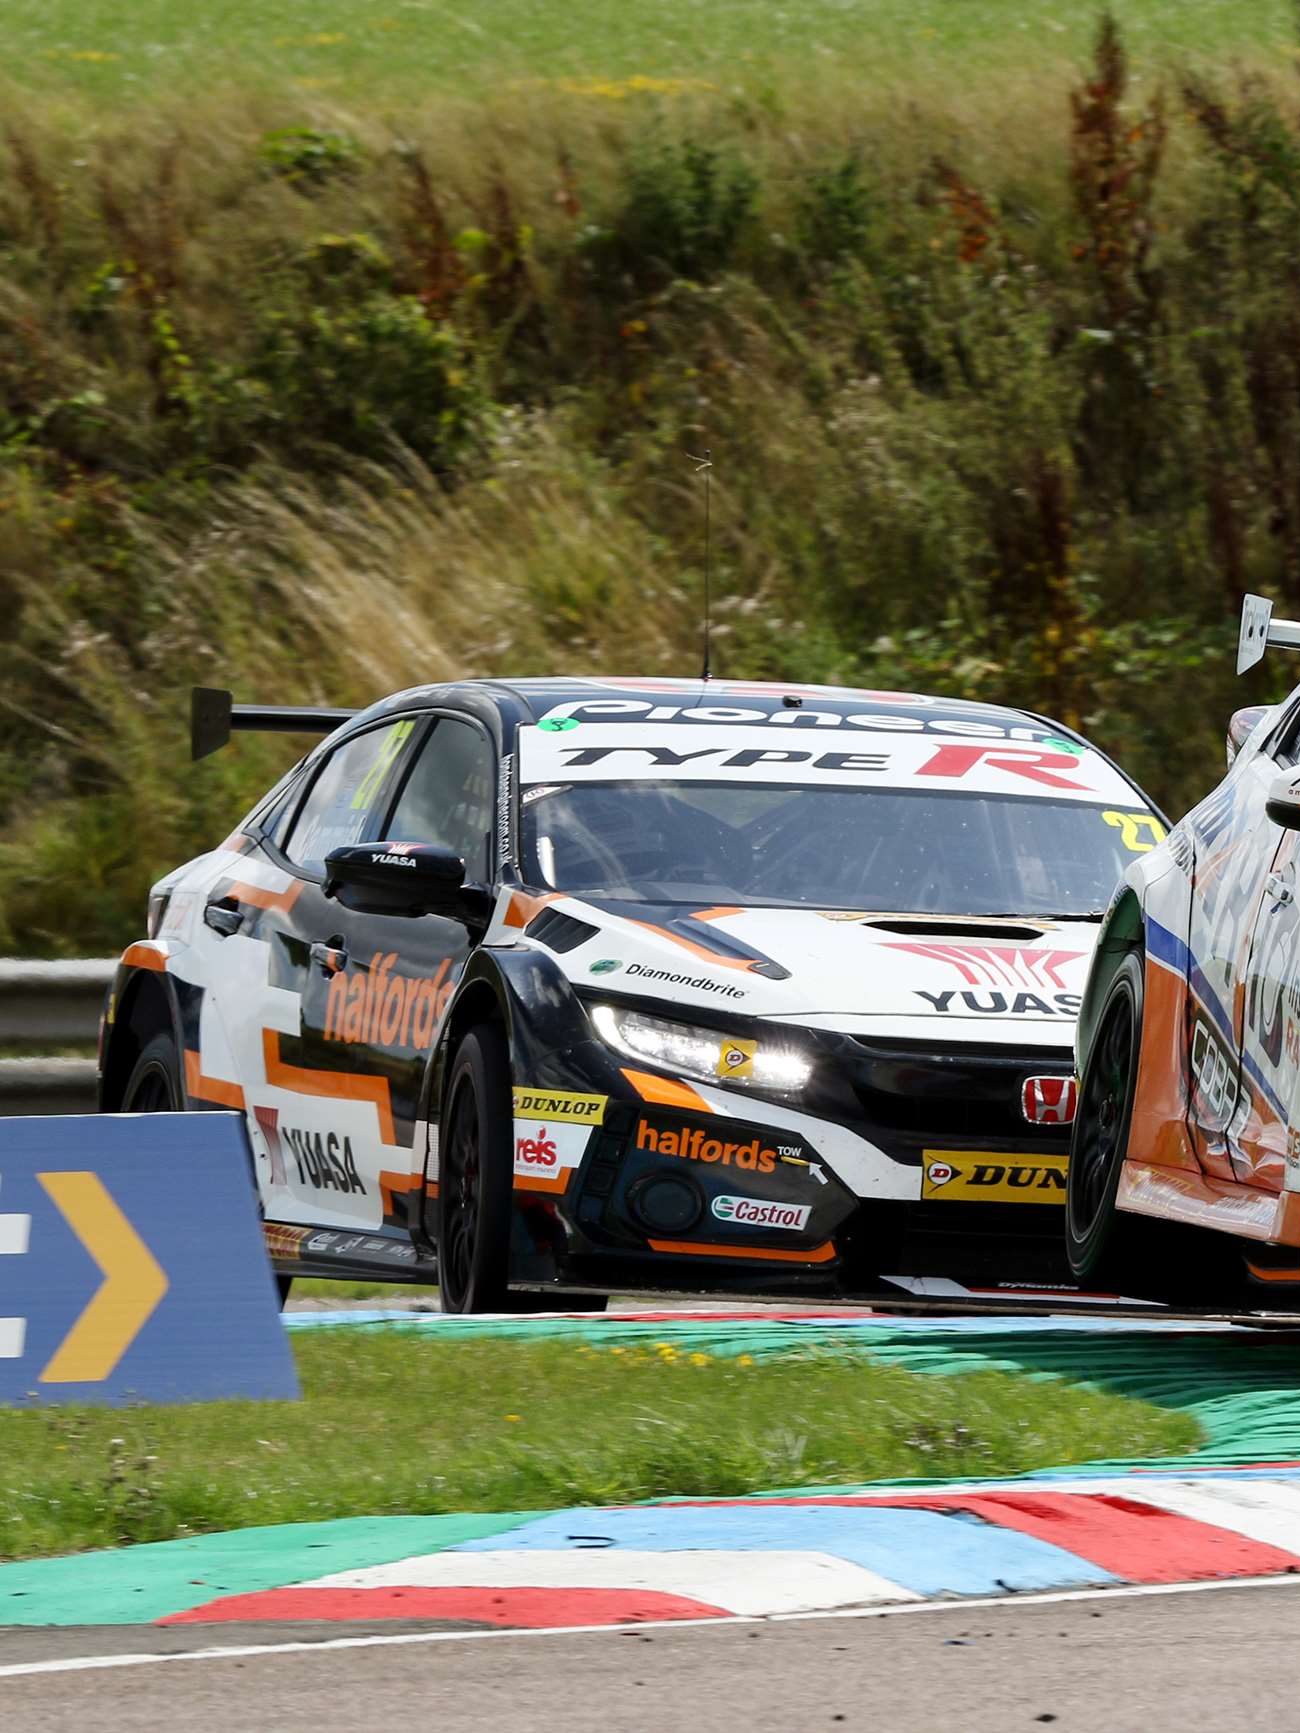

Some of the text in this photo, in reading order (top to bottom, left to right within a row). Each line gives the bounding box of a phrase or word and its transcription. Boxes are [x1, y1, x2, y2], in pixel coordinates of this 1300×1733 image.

[537, 699, 1053, 741] Pioneer
[557, 743, 1100, 793] TYPE R
[1102, 811, 1174, 853] 27
[370, 853, 417, 868] YUASA
[624, 963, 745, 1000] Diamondbrite
[911, 990, 1083, 1016] YUAS
[519, 1096, 601, 1116] DUNLOP
[282, 1126, 367, 1196] YUASA
[516, 1126, 557, 1167] reis
[636, 1119, 778, 1174] halfords
[777, 1146, 802, 1157] TOW
[965, 1163, 1068, 1190] DUN
[734, 1200, 803, 1227] Castrol
